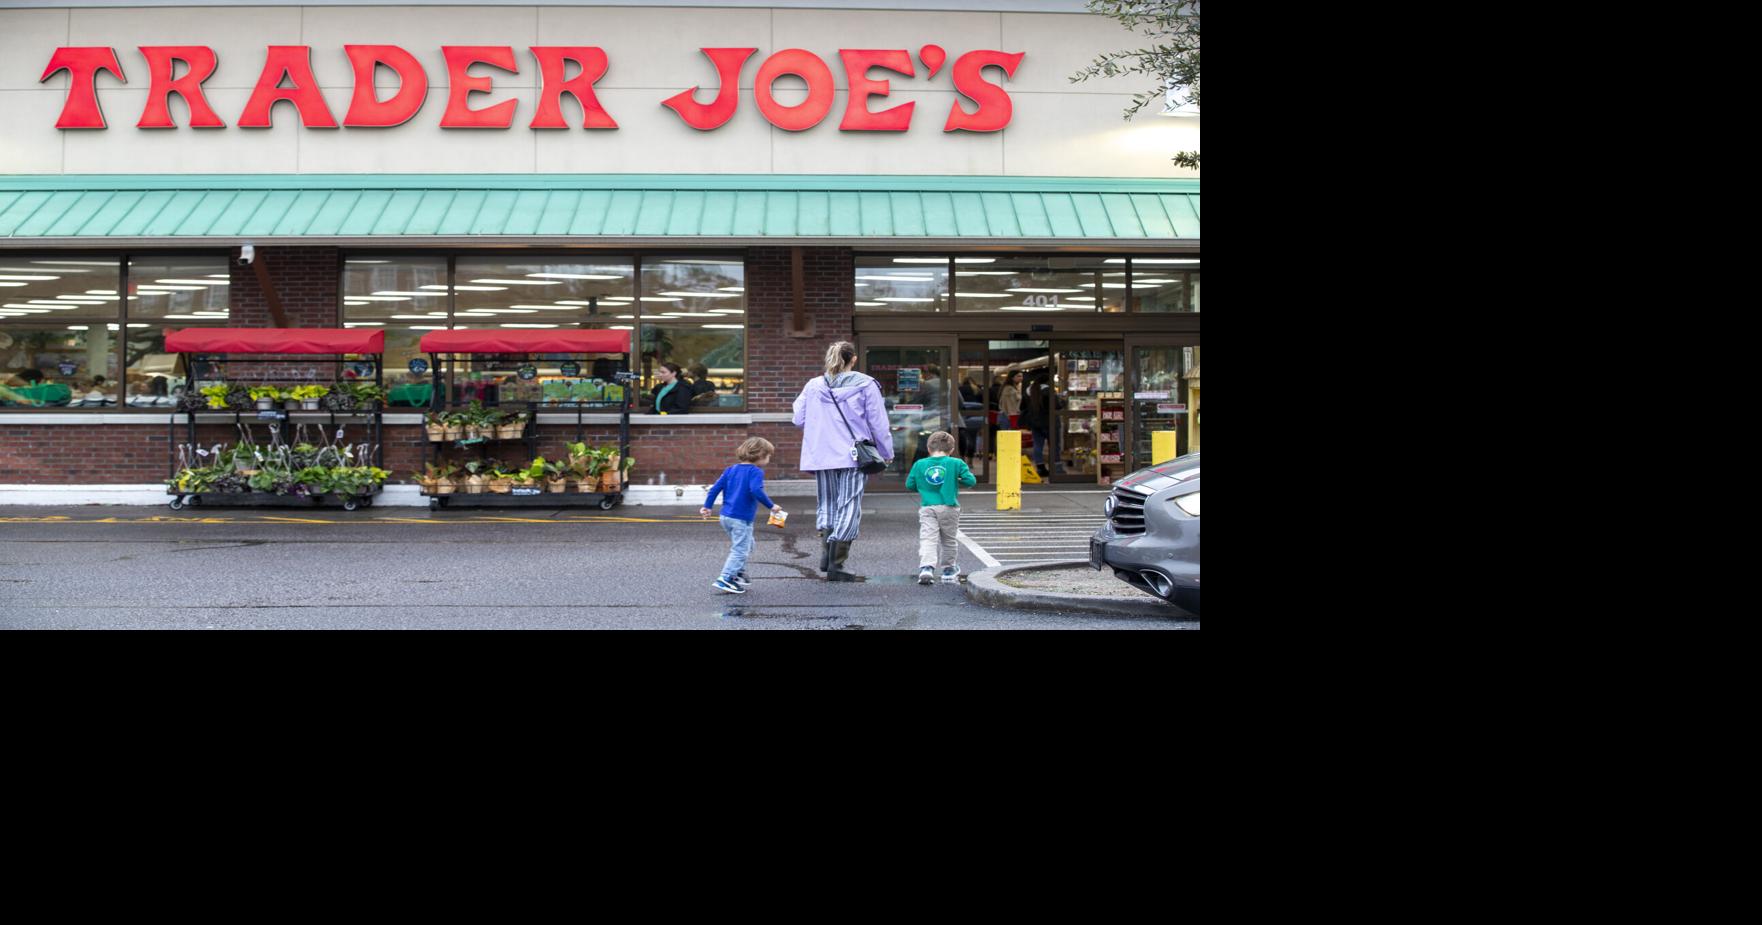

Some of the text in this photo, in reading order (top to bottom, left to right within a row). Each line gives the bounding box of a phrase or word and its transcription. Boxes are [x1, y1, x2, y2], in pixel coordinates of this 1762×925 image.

[39, 43, 1027, 132] TRADER JOE'S
[1022, 294, 1059, 307] 401
